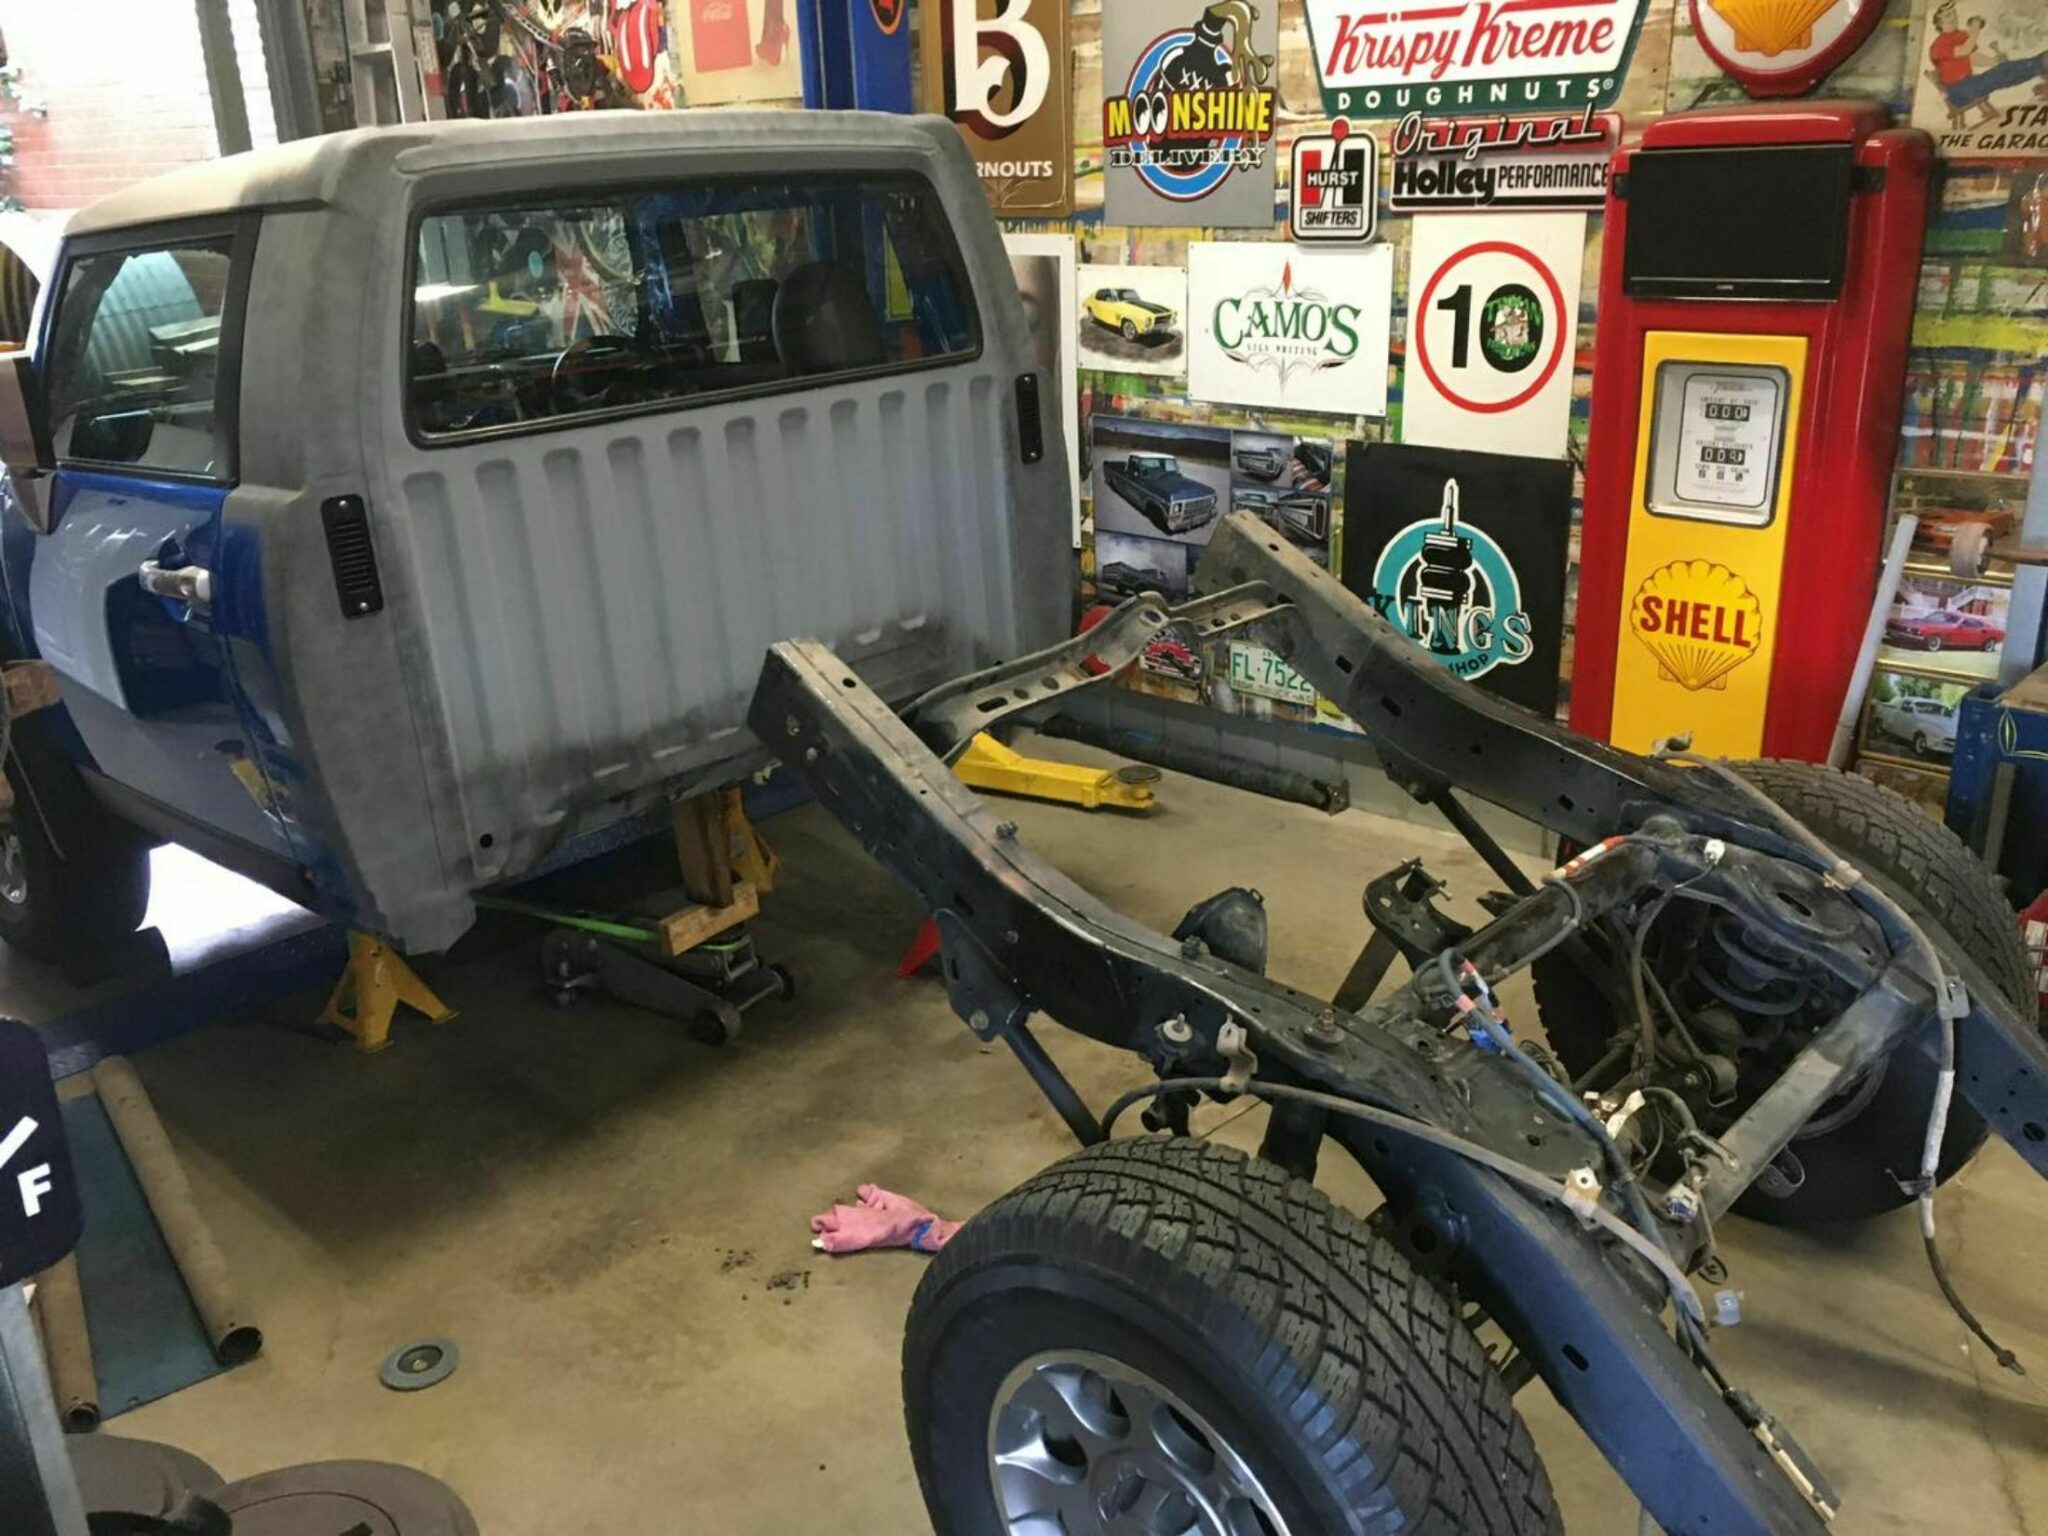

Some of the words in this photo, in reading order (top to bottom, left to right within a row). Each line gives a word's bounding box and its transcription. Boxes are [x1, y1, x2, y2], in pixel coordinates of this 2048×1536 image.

[1325, 4, 1468, 80] Krispy
[1461, 0, 1617, 67] Kreme
[1108, 90, 1273, 138] MOONSHINE
[1338, 78, 1600, 110] DOUGHNUTS
[1393, 102, 1602, 160] Original
[1940, 134, 1973, 148] THE
[1111, 147, 1266, 168] DELIVERY
[1307, 171, 1358, 186] HURST
[1393, 161, 1497, 204] Holley
[1498, 163, 1608, 189] PERFORMANCE
[1305, 210, 1358, 226] SHIFTERS
[1213, 297, 1362, 357] CAMO'S
[1437, 283, 1544, 374] 10
[1640, 595, 1751, 648] SHELL
